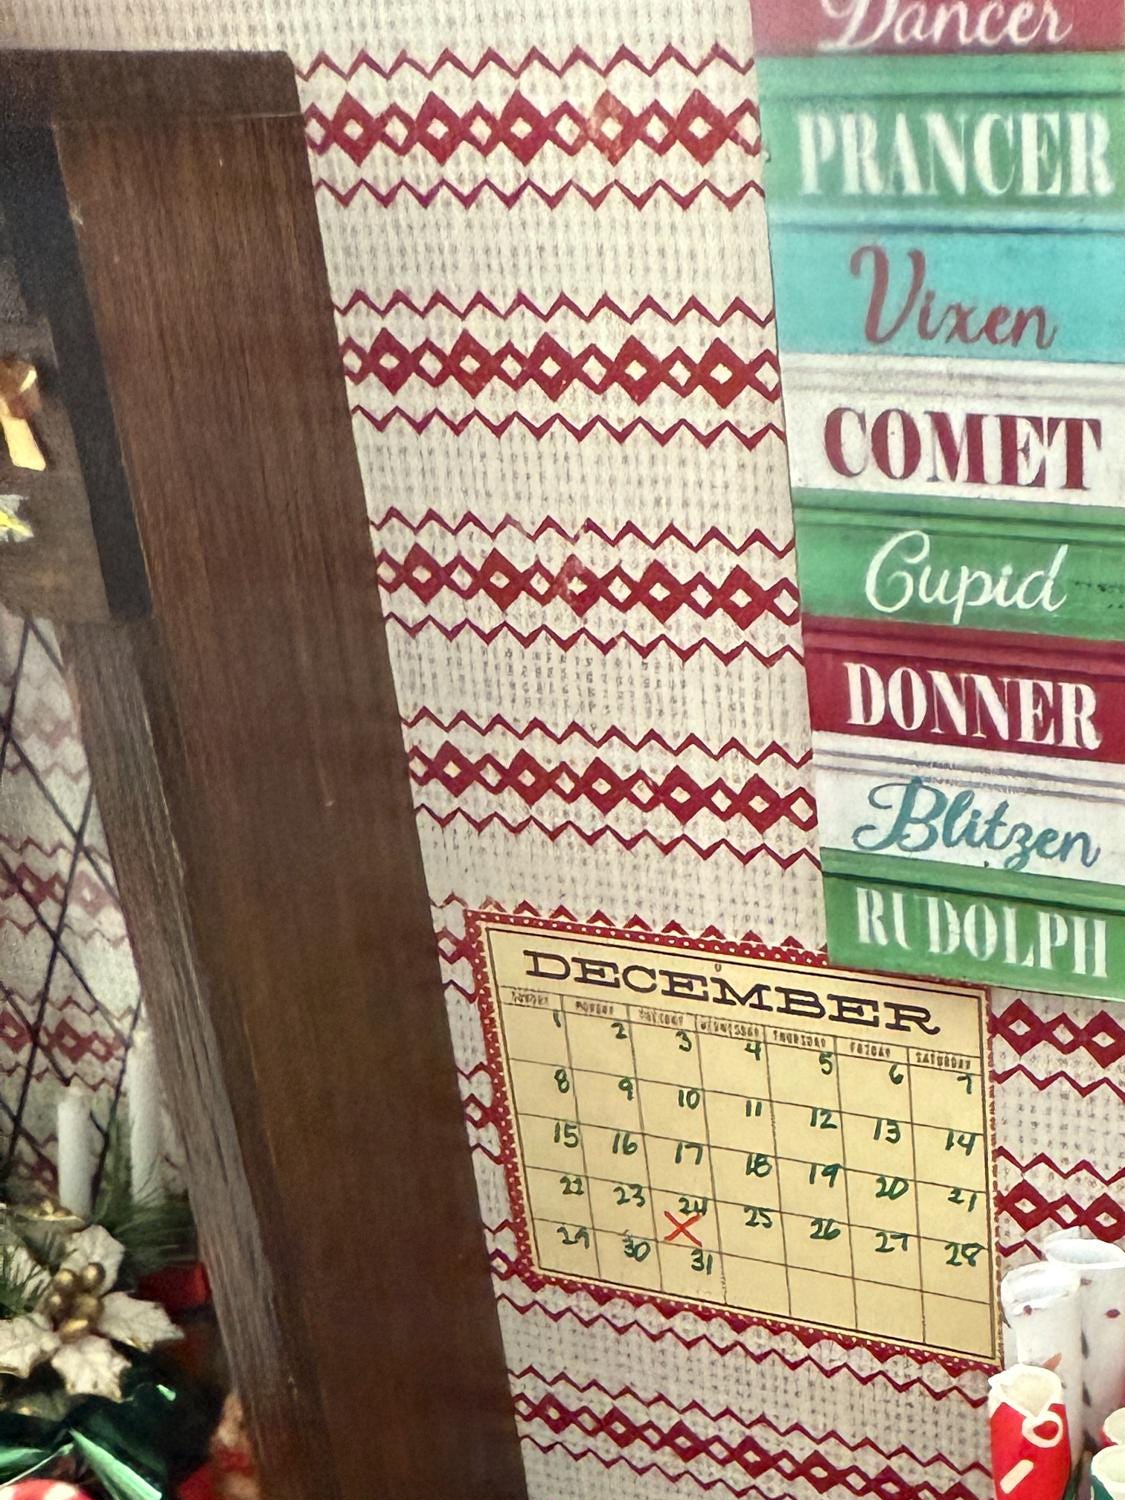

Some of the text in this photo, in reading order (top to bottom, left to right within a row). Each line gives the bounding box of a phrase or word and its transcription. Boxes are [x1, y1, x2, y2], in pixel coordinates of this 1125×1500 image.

[818, 0, 1072, 52] Dancer
[797, 111, 1114, 198] PRANCER
[850, 243, 1057, 351] Vixen
[823, 406, 1102, 491] COMET
[864, 529, 1069, 625] Cupid
[842, 660, 1102, 752] DONNER
[851, 775, 1101, 872] Blitzen
[855, 886, 1108, 980] RUDOLPH
[523, 949, 941, 1035] DECEMBER
[553, 1010, 972, 1095] 1 2 3 4 5 6 7
[554, 1069, 976, 1156] 8 9 10 11 12 13 14
[553, 1122, 977, 1212] 15 16 17 18 19 20 21
[557, 1226, 713, 1275] 29 30 31
[560, 1176, 984, 1267] 22 23 24 25 26 27 28
